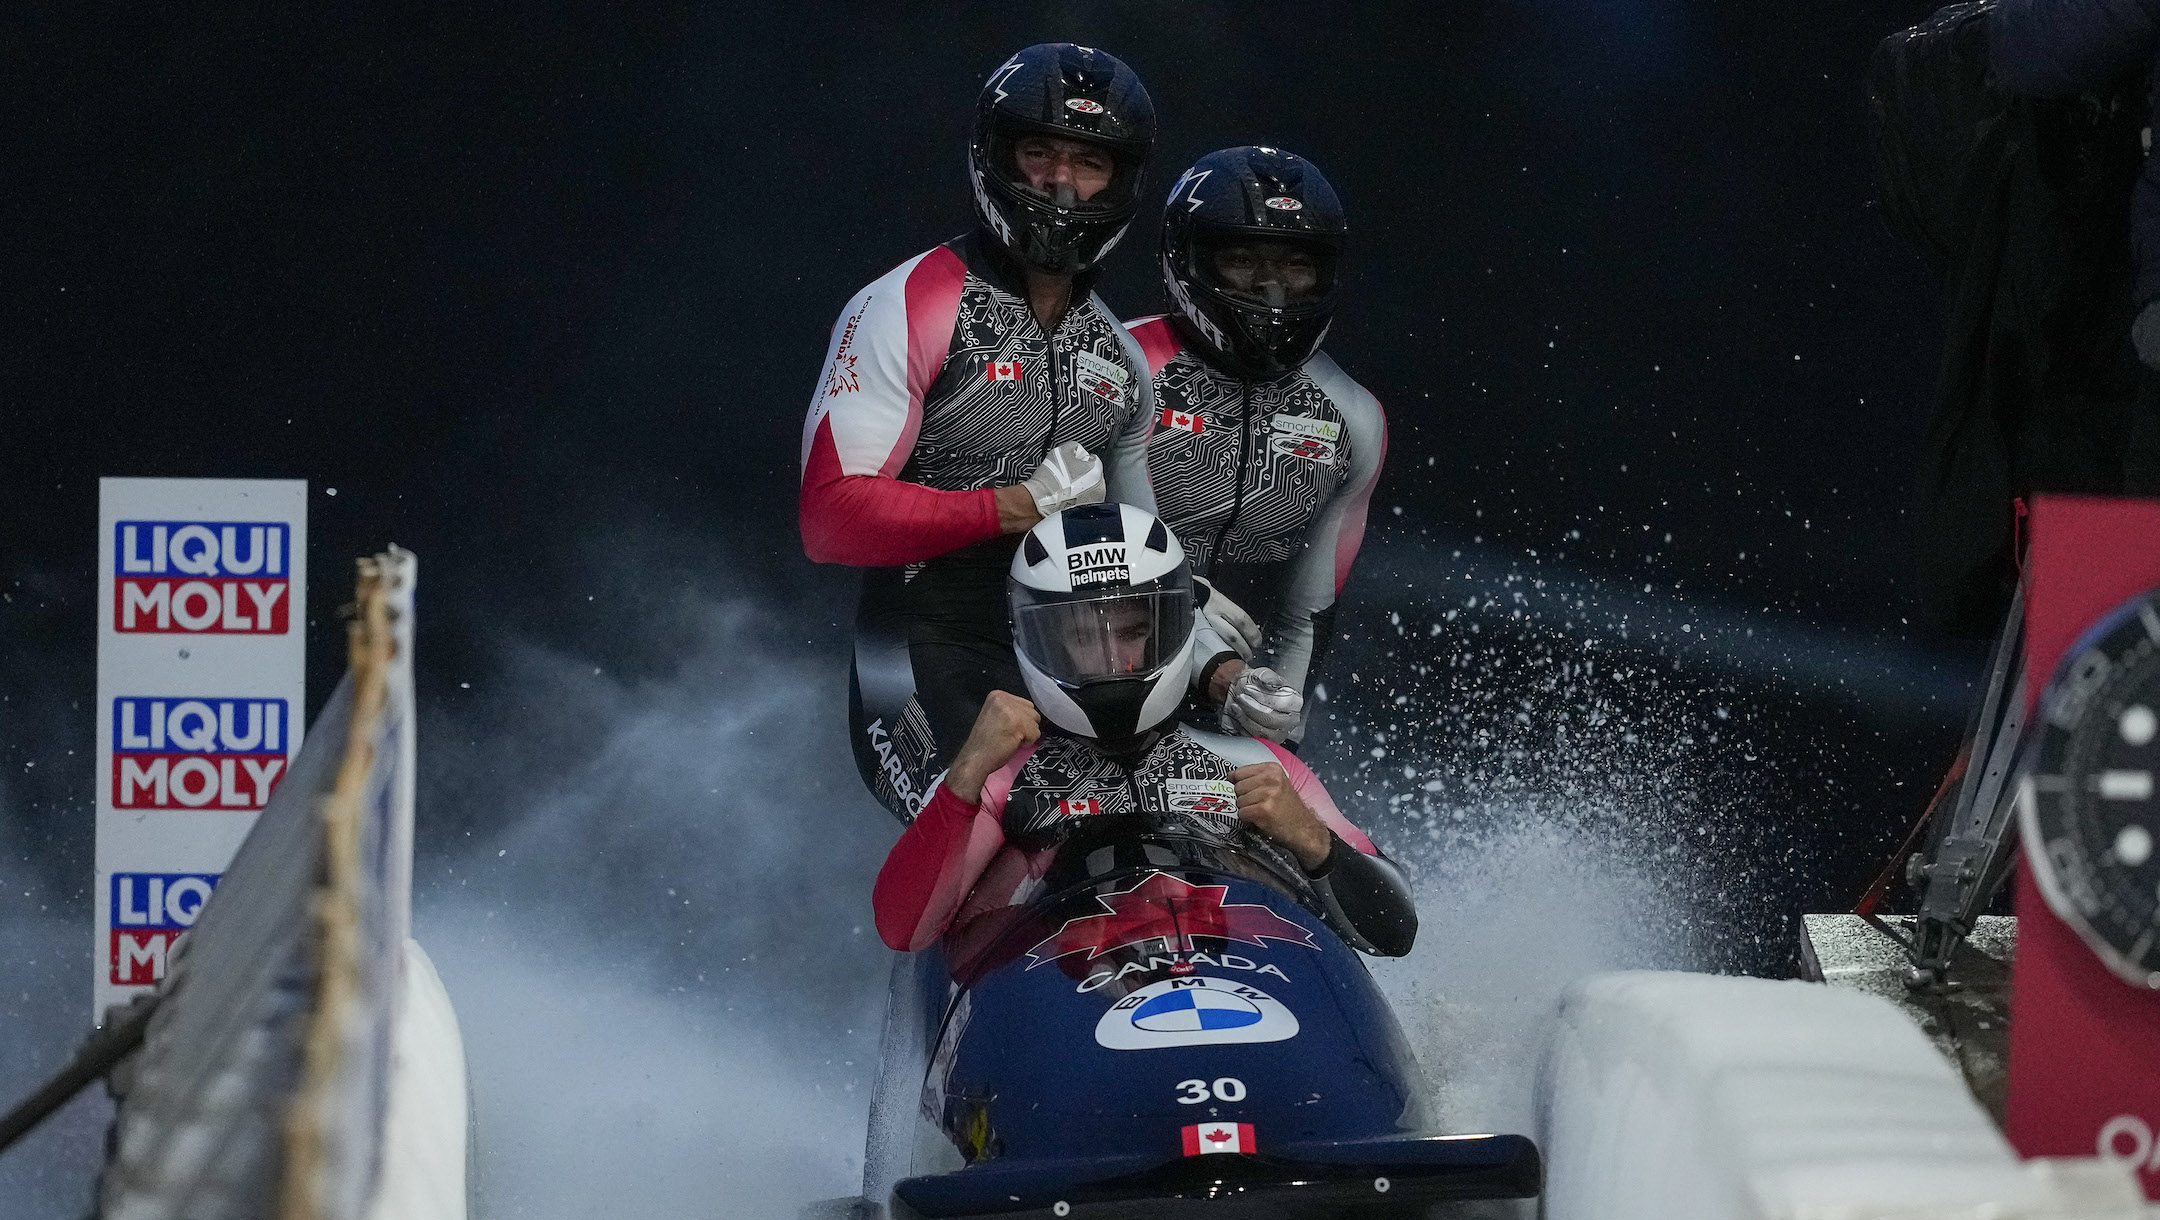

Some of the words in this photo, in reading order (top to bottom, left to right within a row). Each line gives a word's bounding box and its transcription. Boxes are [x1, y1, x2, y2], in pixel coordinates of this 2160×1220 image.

[835, 315, 857, 361] CANADA
[1275, 420, 1338, 439] smartvita
[122, 525, 283, 578] LIQUI
[1067, 548, 1127, 571] BMW
[1070, 567, 1129, 587] helmets
[121, 580, 287, 633] MOLY
[120, 700, 281, 753] LIQUI
[119, 755, 285, 807] MOLY
[866, 717, 924, 821] KARBO
[1167, 781, 1235, 795] smartvita
[119, 876, 222, 928] LIQ
[1075, 952, 1292, 994] CANADA
[1112, 978, 1272, 1011] BMW
[1175, 1077, 1247, 1105] 30
